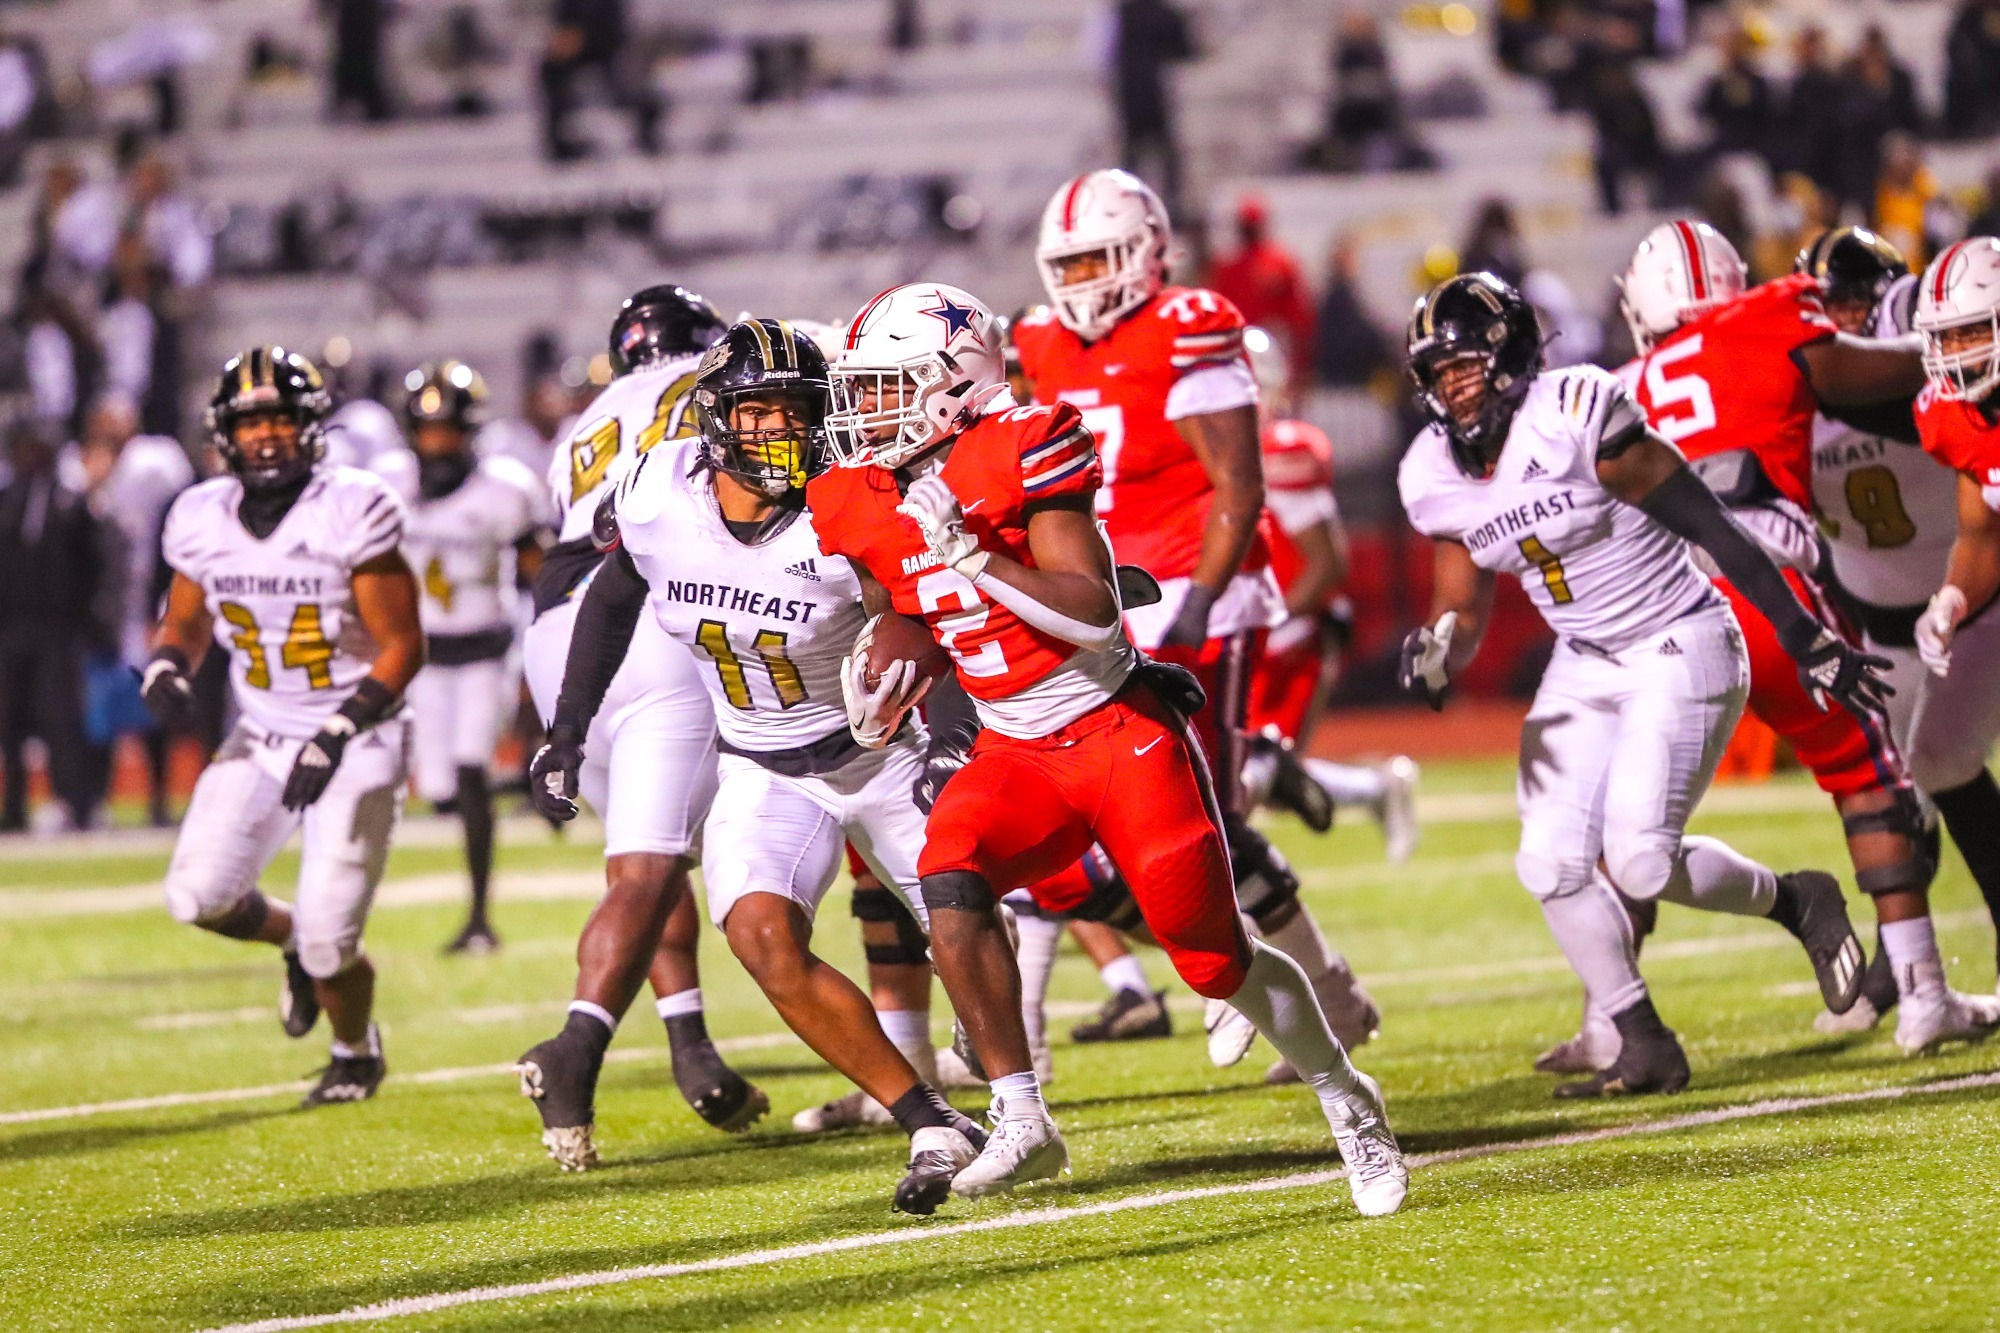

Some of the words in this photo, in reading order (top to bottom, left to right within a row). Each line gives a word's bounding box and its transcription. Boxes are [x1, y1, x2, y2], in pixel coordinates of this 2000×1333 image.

[764, 370, 800, 379] Riddell
[1466, 489, 1576, 553] NORTHEAST
[213, 575, 321, 595] NORTHEAST
[784, 567, 821, 581] adidas
[1516, 531, 1574, 605] 1
[667, 580, 817, 624] NORTHEAST
[917, 567, 1009, 677] 2
[219, 600, 335, 691] 34
[695, 618, 810, 711] 11
